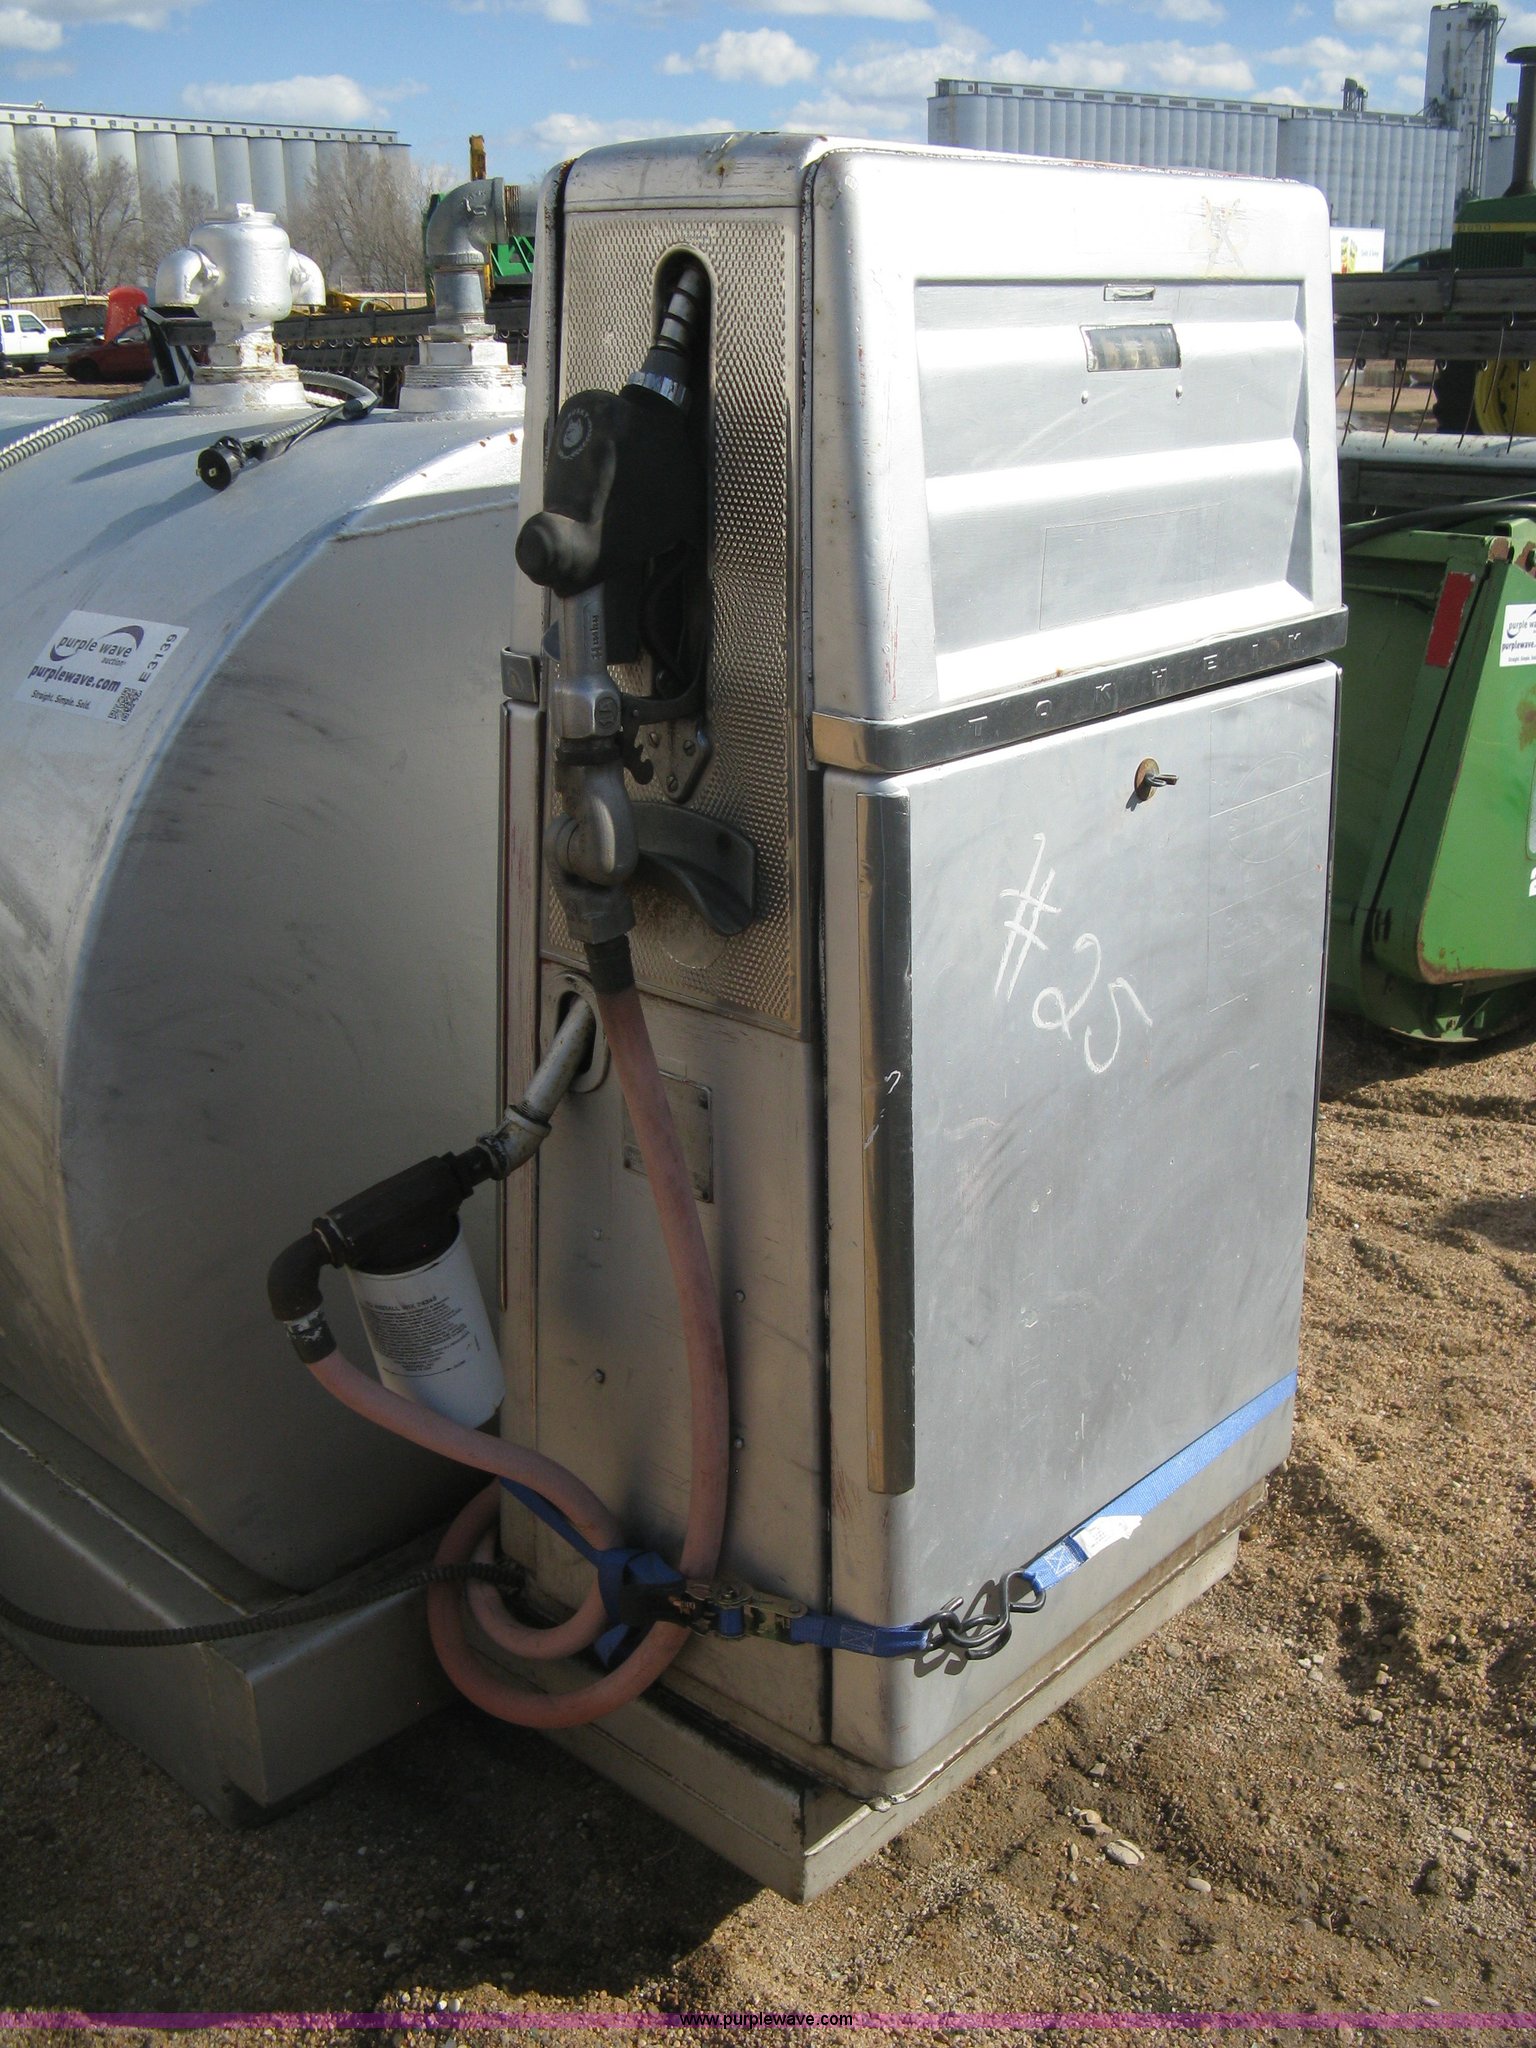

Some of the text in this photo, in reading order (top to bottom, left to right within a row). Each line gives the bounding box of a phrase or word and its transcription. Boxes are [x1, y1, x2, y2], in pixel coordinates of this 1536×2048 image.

[56, 635, 132, 658] purple wave
[138, 633, 178, 683] E3139
[27, 664, 122, 693] purplewave.com
